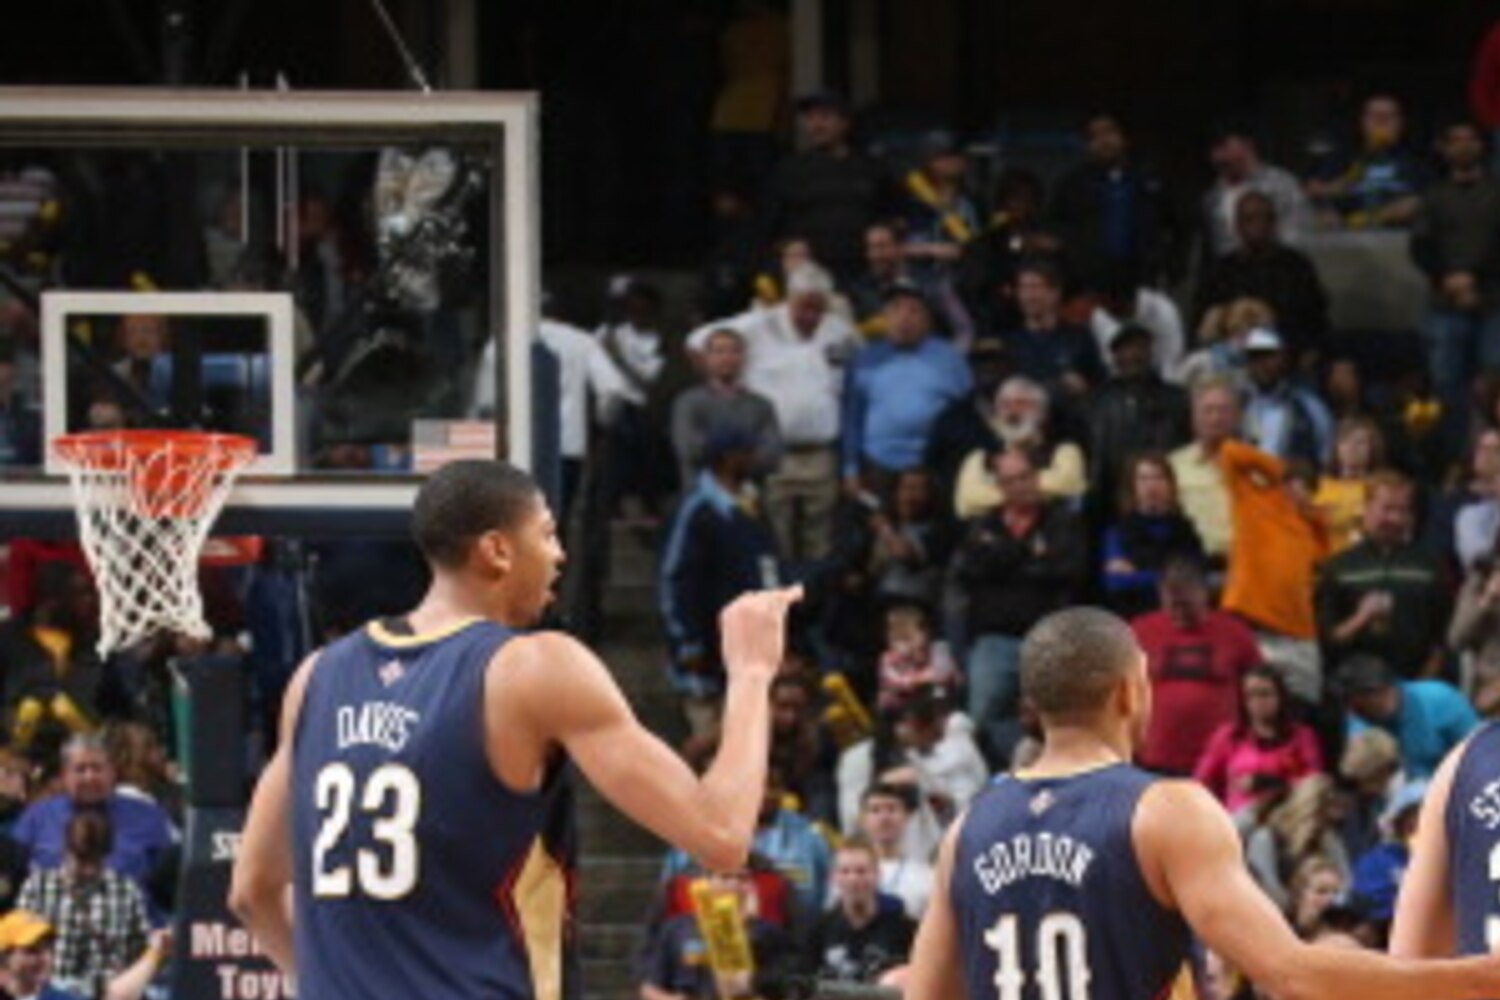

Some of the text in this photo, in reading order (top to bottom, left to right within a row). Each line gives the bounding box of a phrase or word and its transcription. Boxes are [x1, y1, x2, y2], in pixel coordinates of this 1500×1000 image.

[337, 701, 420, 752] DAVIS
[312, 761, 421, 899] 23
[974, 831, 1094, 895] GORDON
